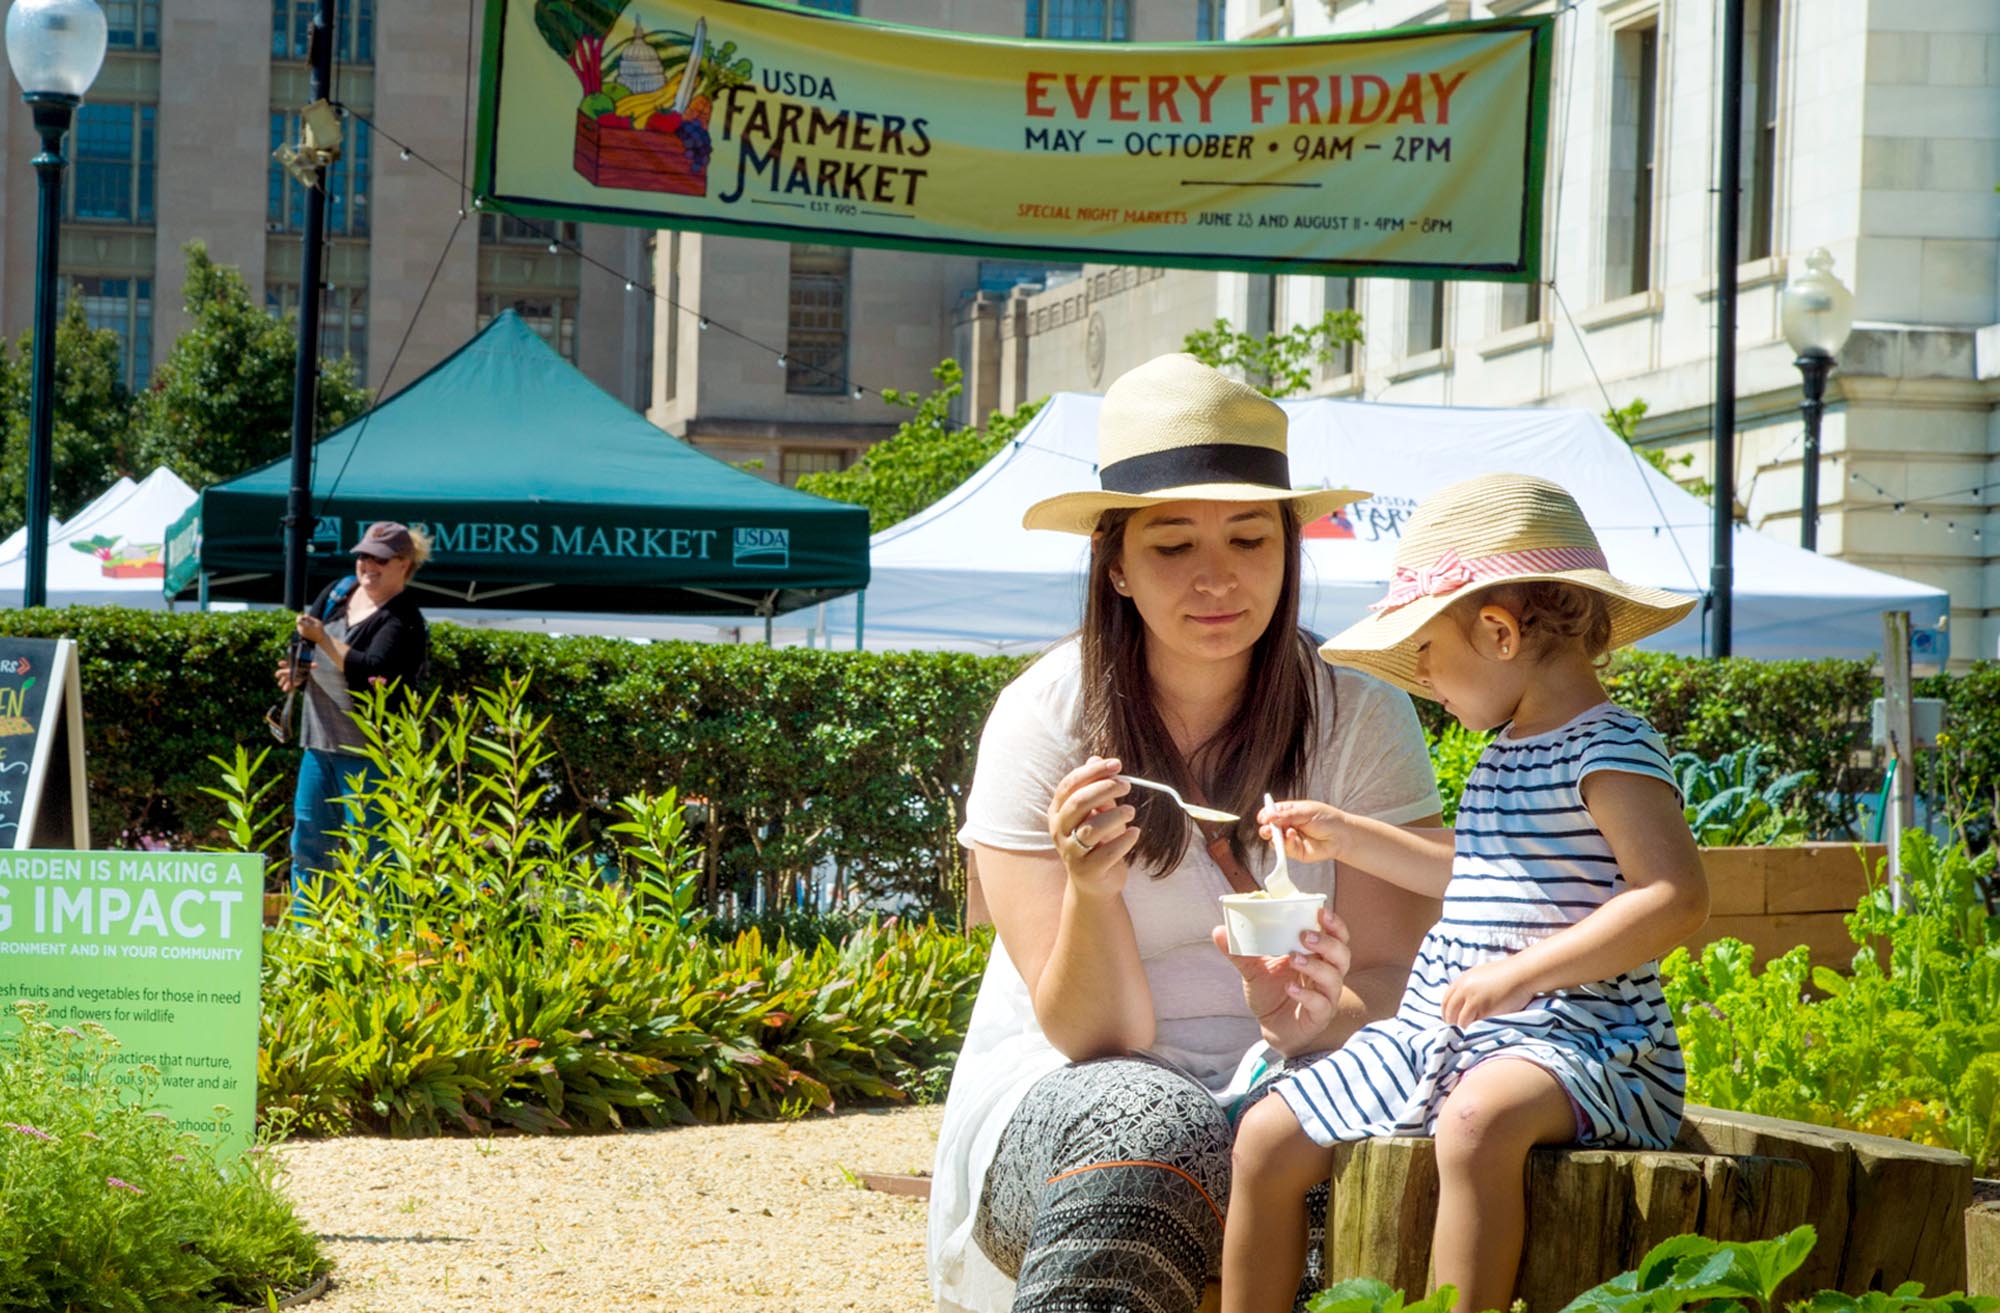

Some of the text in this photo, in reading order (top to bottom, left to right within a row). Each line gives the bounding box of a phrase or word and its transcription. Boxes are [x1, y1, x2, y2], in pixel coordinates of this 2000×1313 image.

[762, 68, 837, 101] USDA
[1025, 72, 1468, 124] EVERY FRIDAY
[711, 83, 932, 158] FARMERS
[1024, 127, 1086, 153] MAY
[1124, 132, 1255, 159] OCTOBER
[1293, 134, 1355, 162] 9AM
[1392, 136, 1453, 163] 2PM
[718, 134, 929, 206] MARKET
[1017, 203, 1071, 220] SPECIAL
[1075, 207, 1120, 222] NIGHT
[1123, 209, 1189, 225] MARKETS
[1197, 211, 1233, 227] JUNE
[1257, 213, 1289, 229] AND
[1293, 214, 1349, 231] AUGUST
[1374, 217, 1405, 232] 4PM
[551, 525, 716, 559] MARKET
[733, 529, 788, 547] USDA
[90, 859, 111, 882] IS
[119, 860, 217, 884] MAKING
[224, 862, 243, 885] A
[35, 886, 243, 939] IMPACT
[70, 943, 99, 957] AND
[103, 944, 117, 957] IN
[120, 945, 157, 958] YOUR
[160, 946, 243, 961] COMMUNITY
[19, 983, 50, 998] fruits
[52, 985, 75, 999] and
[77, 987, 140, 1003] vegetables
[143, 987, 159, 1001] for
[161, 988, 194, 1003] those
[197, 990, 208, 1003] in
[211, 991, 241, 1005] need
[70, 1006, 112, 1020] flowers
[114, 1007, 131, 1021] for
[133, 1009, 175, 1023] wildlife
[159, 1053, 183, 1066] that
[185, 1055, 232, 1070] nurture,
[162, 1075, 195, 1088] water
[197, 1076, 220, 1090] and
[222, 1077, 238, 1090] air
